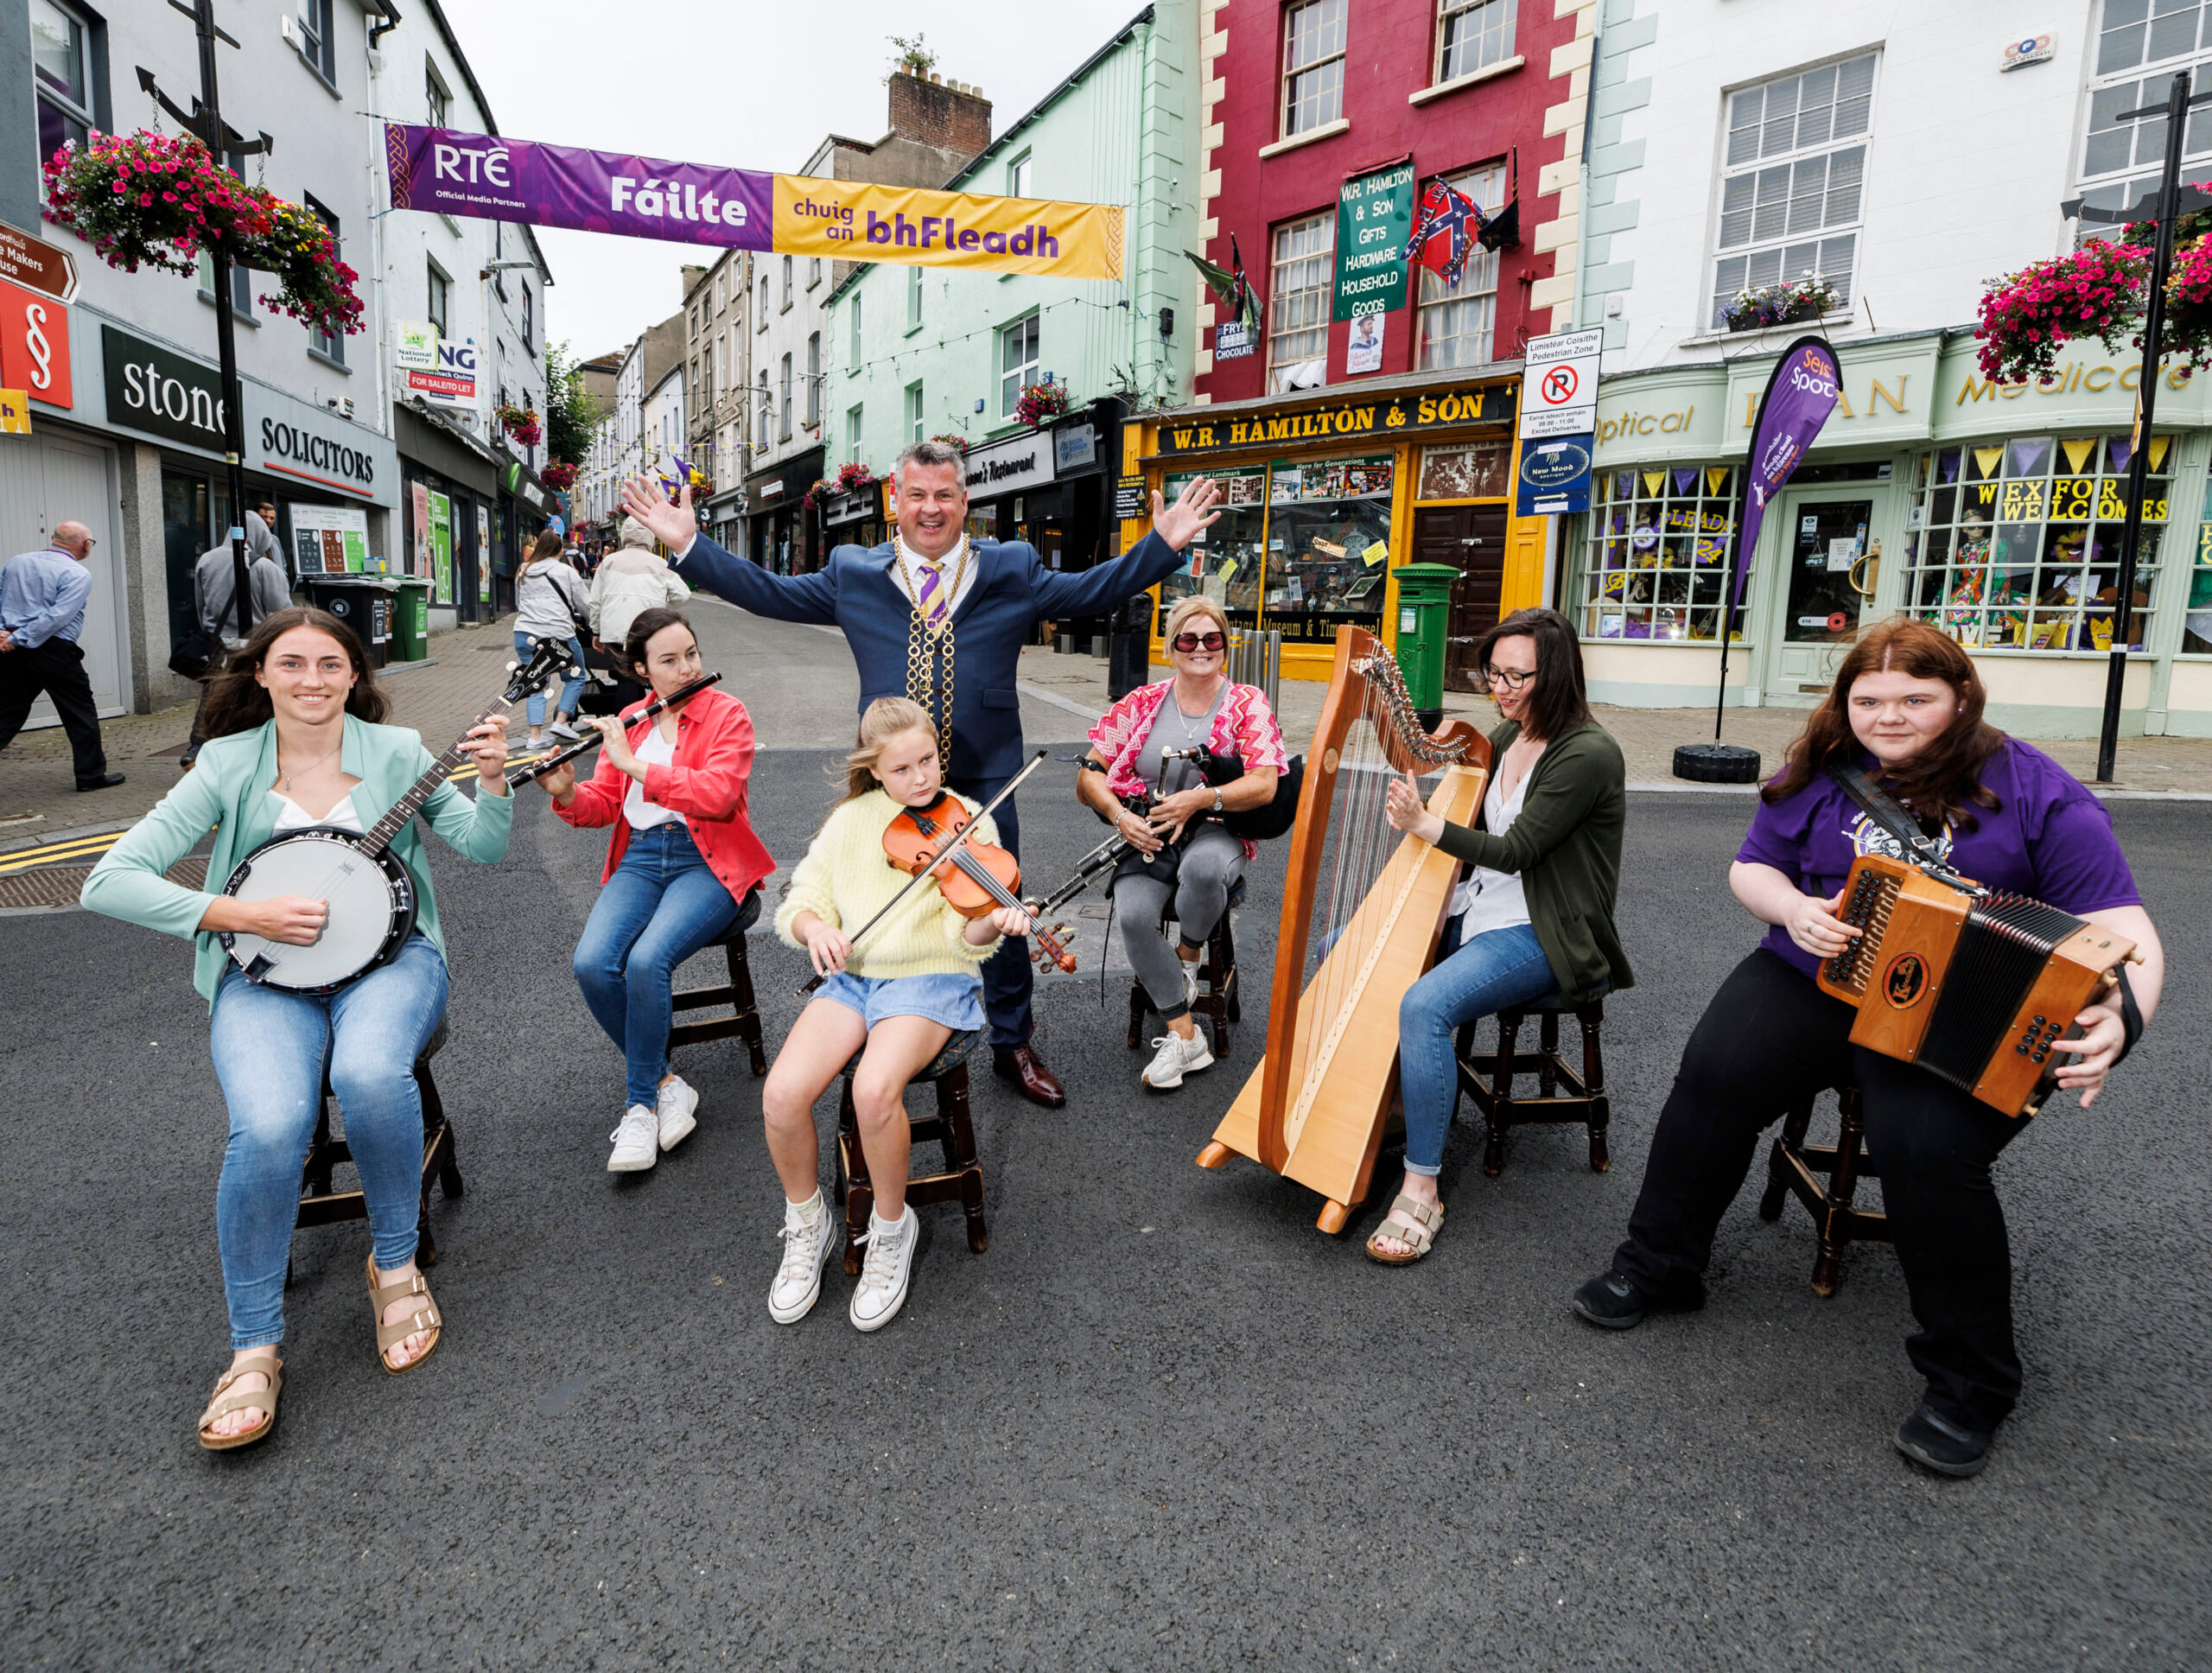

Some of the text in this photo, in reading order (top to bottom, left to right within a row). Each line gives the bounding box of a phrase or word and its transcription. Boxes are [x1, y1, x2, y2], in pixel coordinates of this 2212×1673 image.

[1340, 184, 1362, 202] W.R.
[1366, 167, 1413, 195] HAMILTON
[435, 190, 525, 208] Official Media Partners
[610, 176, 748, 226] Fáilte
[793, 197, 855, 226] chuig
[1356, 199, 1394, 221] & SON
[826, 226, 854, 242] an
[867, 209, 1059, 258] bhFleadh
[1358, 226, 1387, 245] GIFTS
[7, 247, 43, 272] Makers
[1345, 246, 1397, 272] HARDWARE
[1341, 270, 1398, 296] HOUSEHOLD
[1351, 298, 1385, 318] GOODS
[1223, 321, 1244, 335] FRY
[1567, 334, 1599, 346] Coisithe
[398, 349, 432, 358] National
[401, 355, 430, 364] Lottery
[437, 344, 475, 370] NG
[1217, 345, 1254, 360] CHOCOLATE
[1532, 345, 1594, 360] Pedestrian Zone
[411, 377, 471, 393] FOR SALE/TO LET
[1956, 361, 2194, 405] Medicae
[1173, 393, 1485, 450] W.R. HAMILTON & SON
[262, 417, 373, 483] SOLICITORS
[988, 451, 1036, 482] Restaurant
[1325, 458, 1365, 467] Generations
[1551, 464, 1573, 473] Mood
[1977, 479, 2119, 505] WEXFOR
[701, 508, 710, 520] 3
[1263, 618, 1300, 637] Museum
[1306, 619, 1313, 637] &
[1319, 619, 1338, 638] Tim
